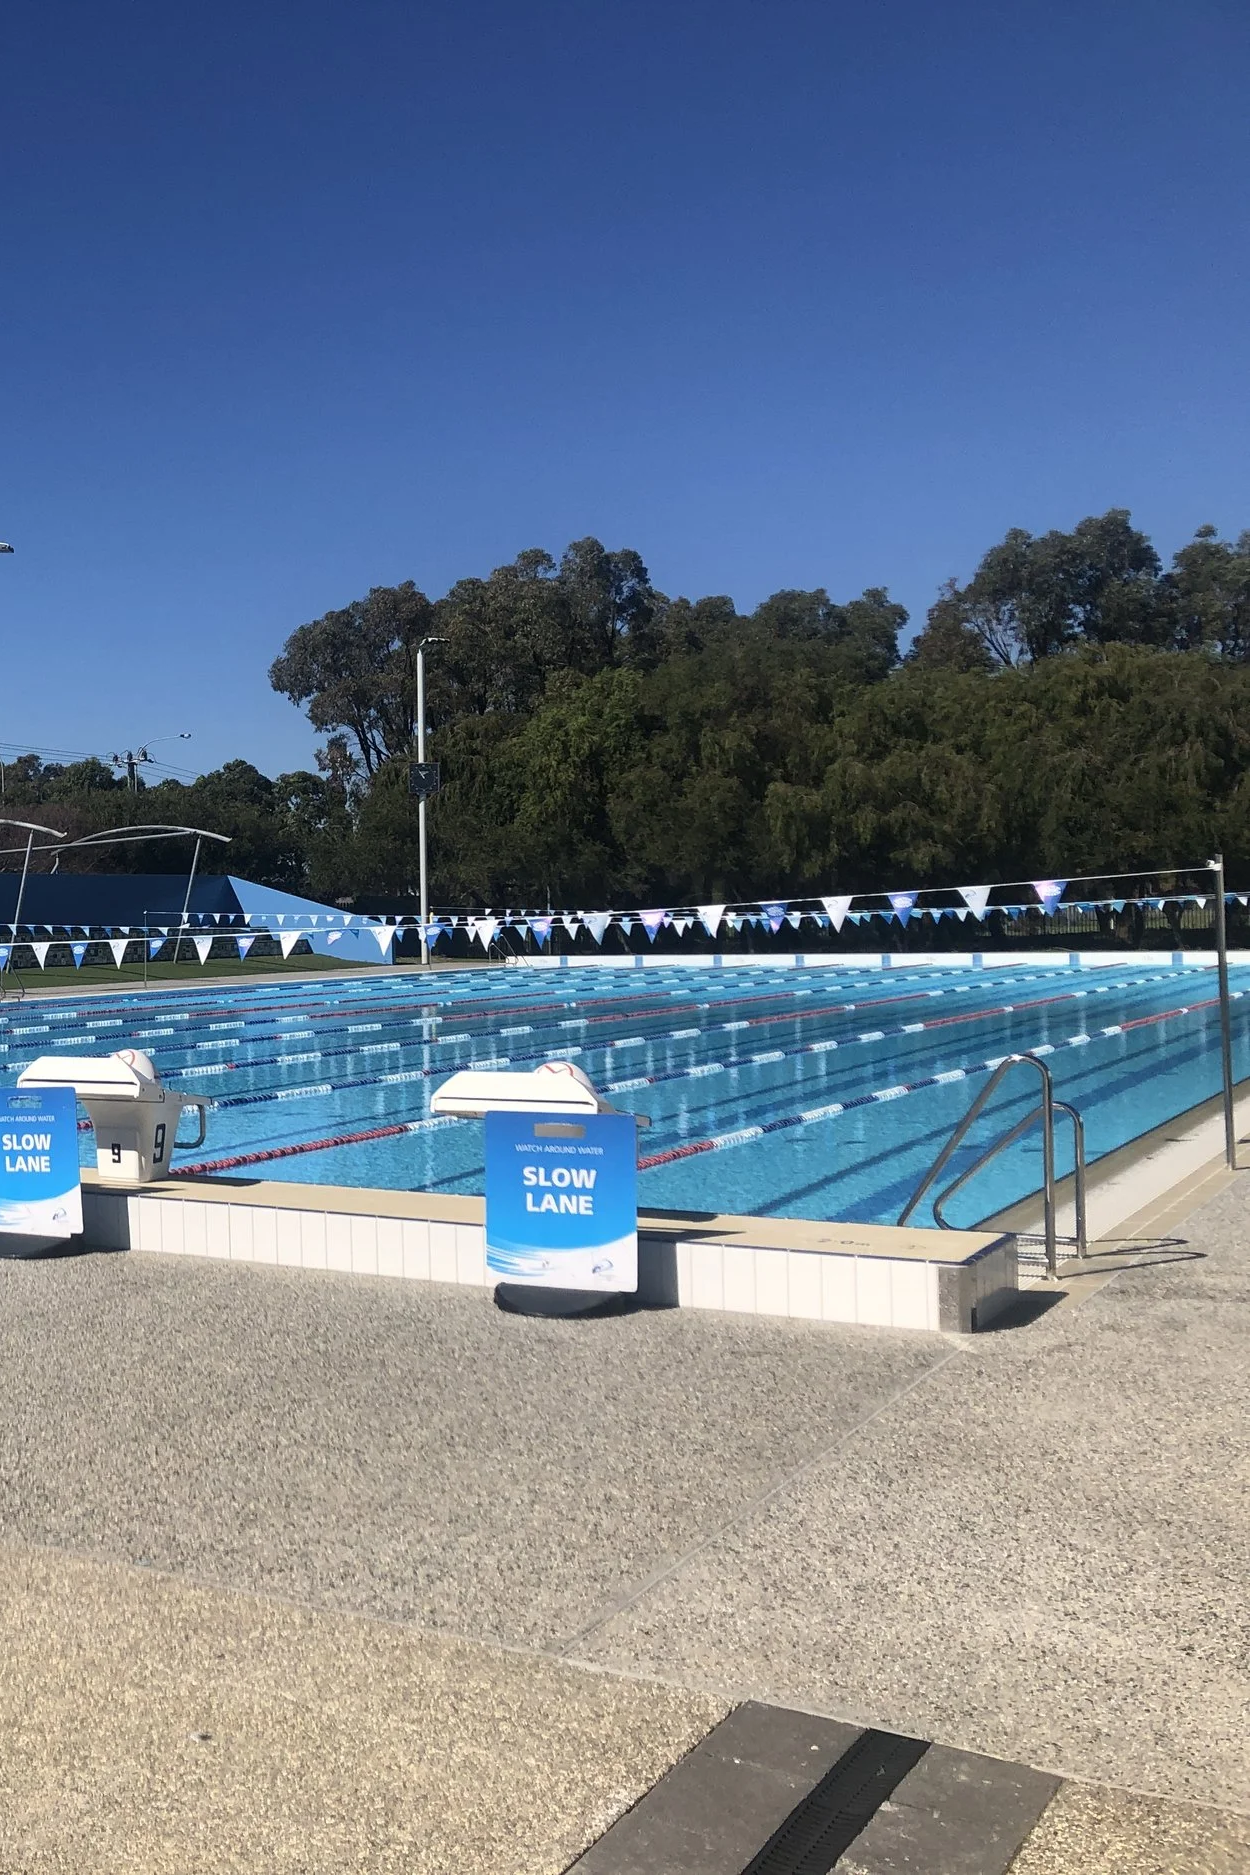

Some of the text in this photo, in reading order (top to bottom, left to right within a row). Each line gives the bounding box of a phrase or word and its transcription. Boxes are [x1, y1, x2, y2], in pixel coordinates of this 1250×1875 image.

[2, 1133, 51, 1150] SLOW
[152, 1123, 166, 1164] 9
[515, 1144, 604, 1155] WATCH AROUND WATER
[111, 1143, 121, 1163] 9
[5, 1155, 51, 1172] LANE
[523, 1166, 597, 1189] SLOW
[526, 1192, 594, 1215] LANE
